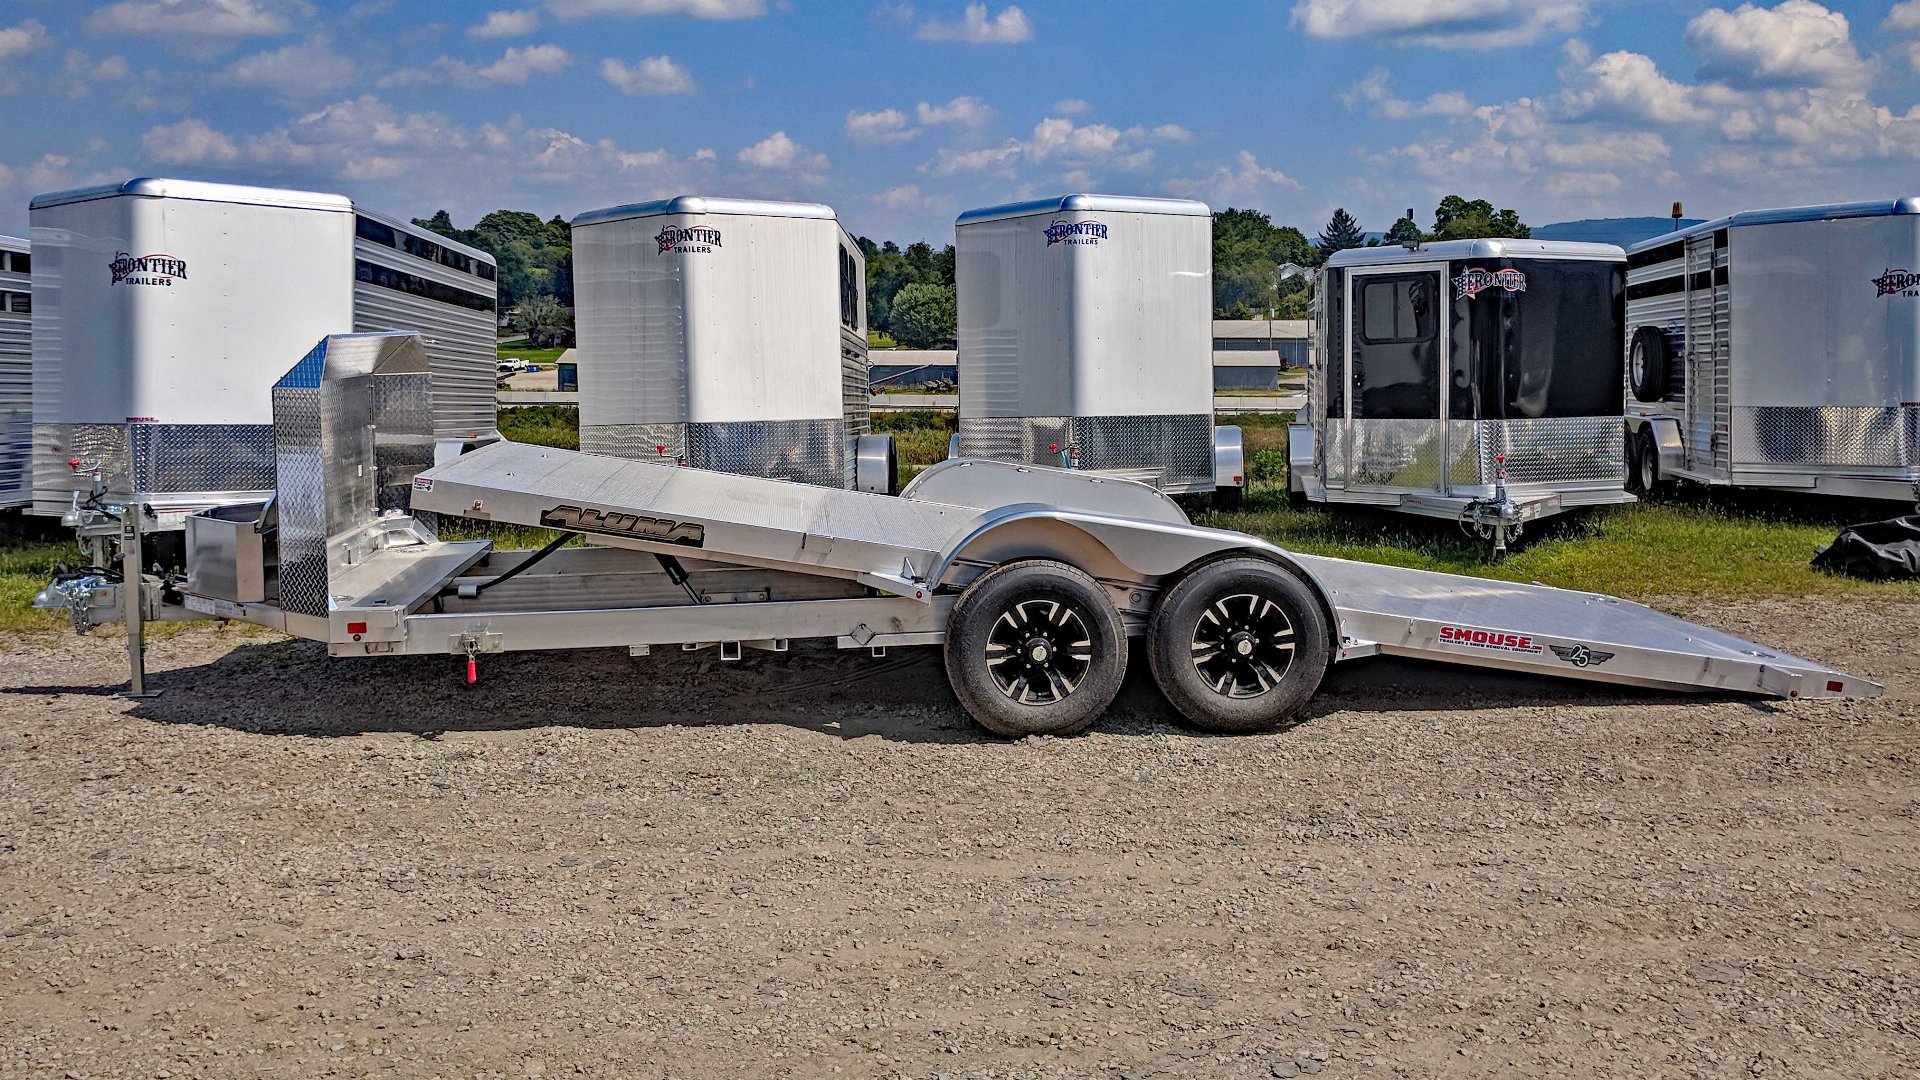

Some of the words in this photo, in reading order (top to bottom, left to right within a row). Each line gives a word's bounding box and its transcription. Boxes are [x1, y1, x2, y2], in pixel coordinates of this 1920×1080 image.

[664, 228, 722, 247] FRONTIER
[1053, 223, 1108, 240] FRONTIER
[116, 258, 187, 279] FRONTIER
[126, 277, 172, 286] TRAILERS
[545, 506, 703, 543] ALUMA
[1571, 645, 1589, 666] 25
